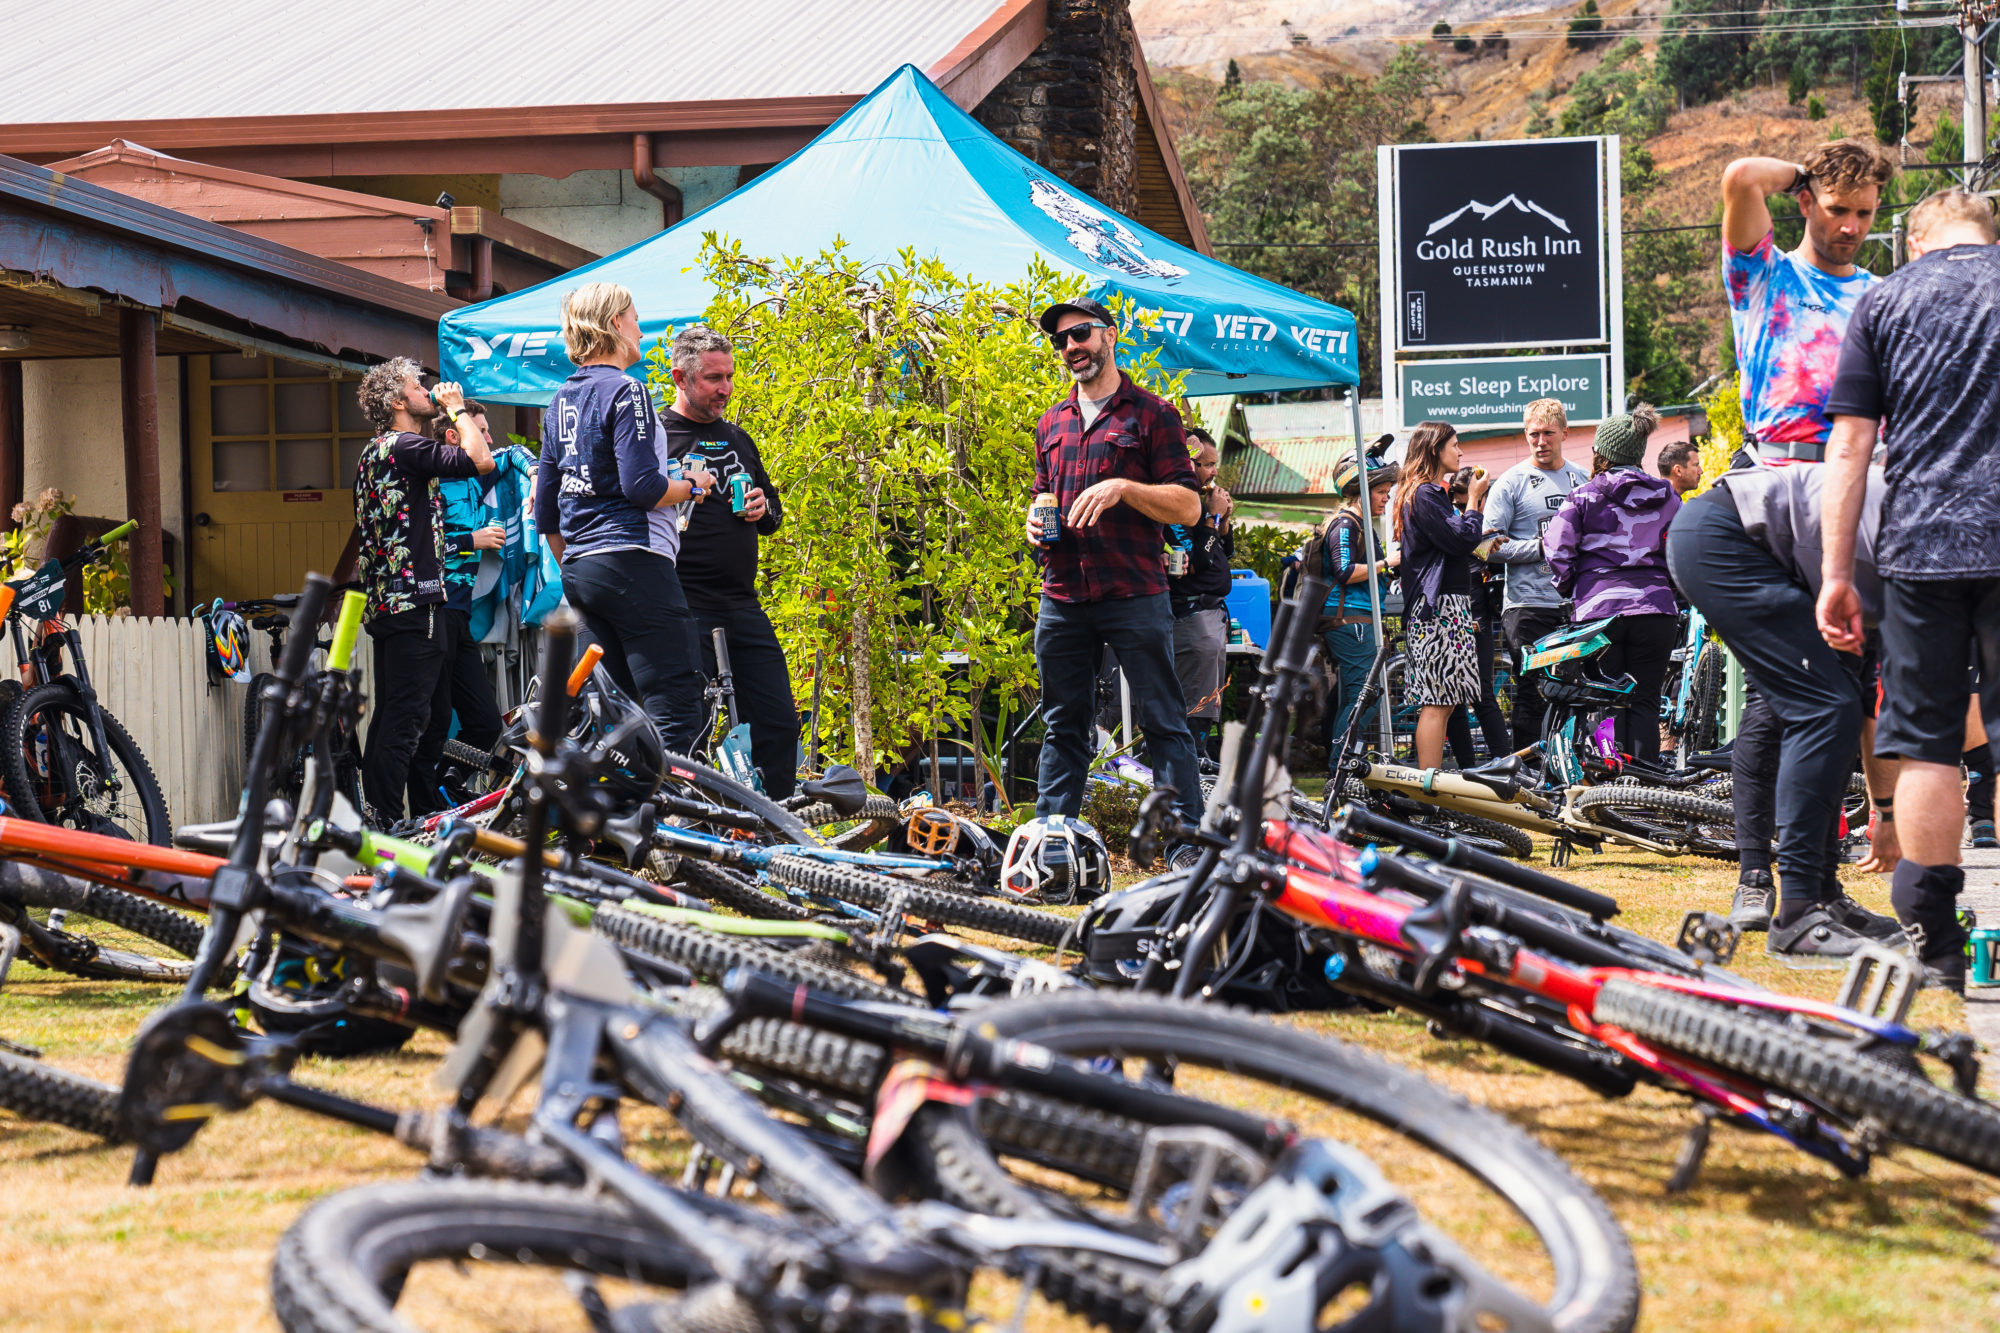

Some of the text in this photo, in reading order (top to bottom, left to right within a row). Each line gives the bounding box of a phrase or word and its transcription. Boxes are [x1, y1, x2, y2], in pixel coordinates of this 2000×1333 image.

[1416, 235, 1581, 260] Gold Rush Inn
[1453, 263, 1545, 276] QUEENSTOWN
[1466, 276, 1533, 287] TASMANIA
[1213, 313, 1278, 342] YETI
[465, 331, 566, 361] YE
[1290, 325, 1350, 354] YETI
[464, 360, 558, 373] CYCL
[1411, 374, 1590, 398] Rest Sleep Explore
[631, 395, 644, 418] BIKE
[635, 420, 647, 441] THE
